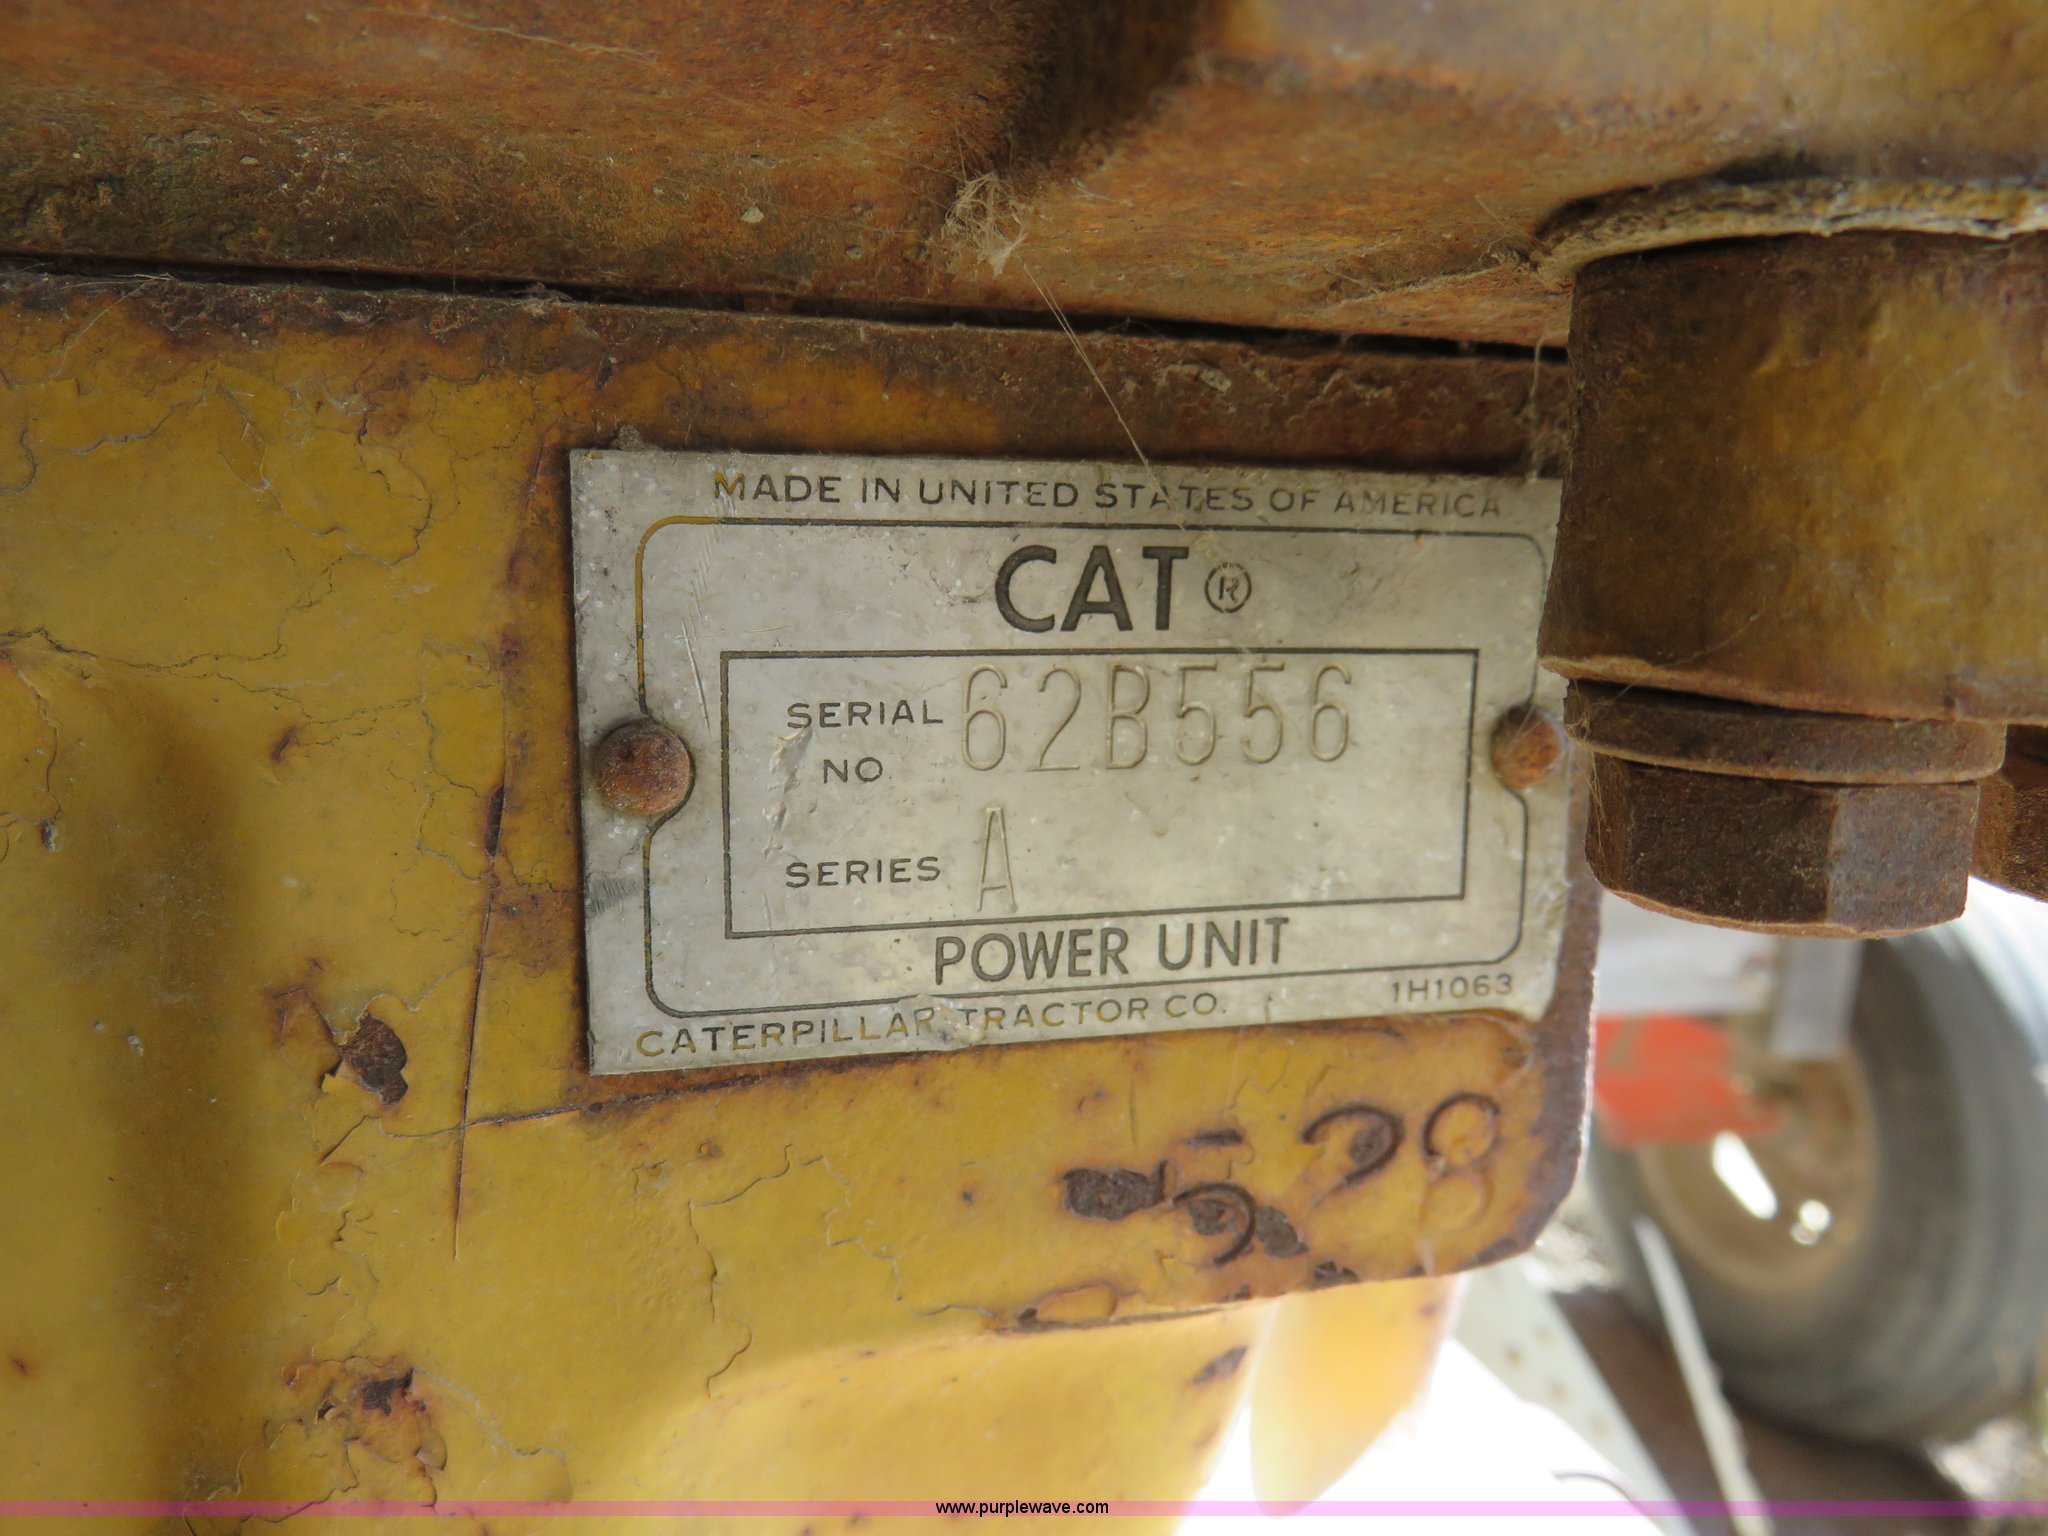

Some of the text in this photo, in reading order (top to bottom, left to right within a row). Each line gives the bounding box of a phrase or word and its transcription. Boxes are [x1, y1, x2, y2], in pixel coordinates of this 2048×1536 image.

[713, 472, 1502, 518] MADE IN UNITED STATES OF AMERICA
[994, 544, 1190, 634] CAT
[787, 699, 944, 728] SERIAL
[961, 663, 1354, 772] 62B556
[823, 757, 884, 785] NO
[785, 806, 1019, 912] SERIES A
[935, 916, 1290, 985] POWER UNIT
[1391, 972, 1514, 1004] 1H1063
[635, 991, 1227, 1058] CATERPILLAR TRACTOR CO.
